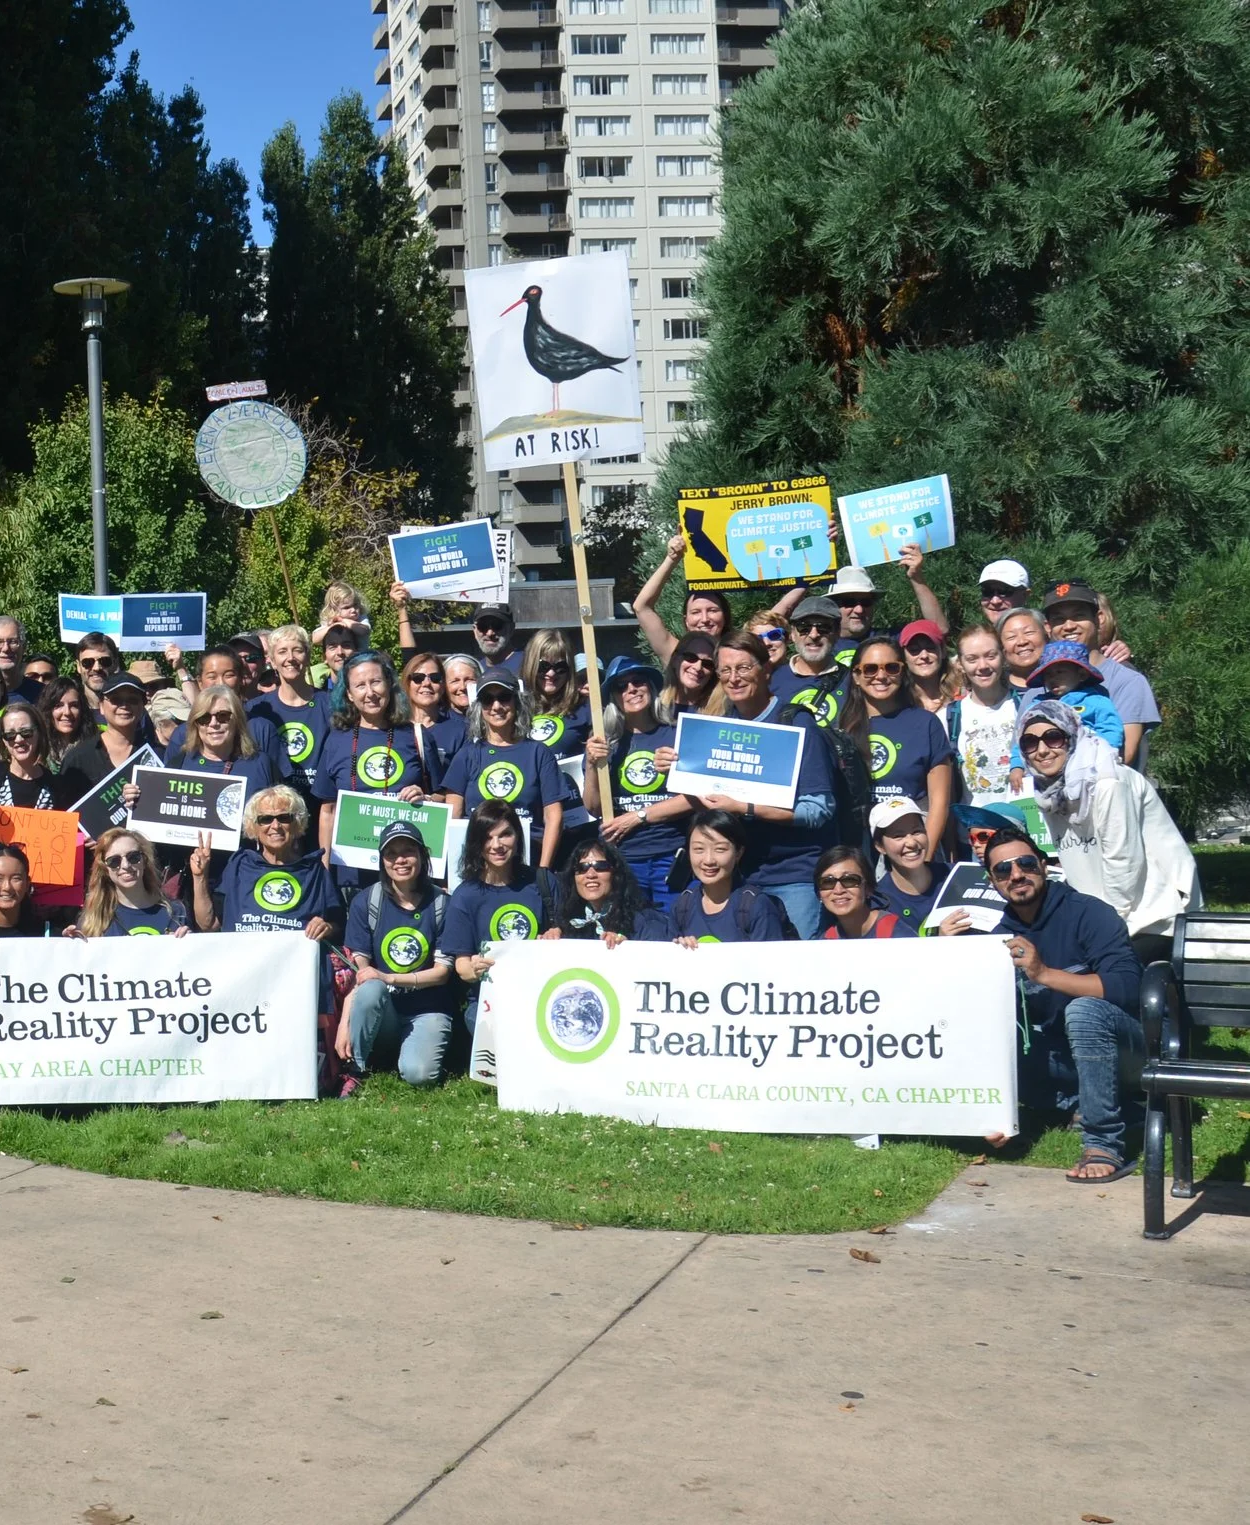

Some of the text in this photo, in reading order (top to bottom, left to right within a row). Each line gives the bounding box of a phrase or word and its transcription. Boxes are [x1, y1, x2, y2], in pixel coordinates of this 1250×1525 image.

[198, 425, 218, 464] EVEN
[212, 414, 223, 426] A
[272, 414, 299, 440] OLD
[515, 428, 600, 457] AT RISK!
[206, 452, 305, 505] CAN CLEAN UP
[680, 475, 827, 498] TEXT "BROWN" TO 69866
[730, 493, 813, 510] JERRY BROWN:
[857, 486, 931, 510] WE STAND FOR
[737, 509, 814, 525] WE STAND FOR
[852, 496, 941, 523] CLIMATE JUSTICE
[731, 520, 823, 537] CLIMATE JUSTICE
[424, 534, 458, 548] FIGHT
[422, 550, 463, 564] YOUR WORLD
[422, 558, 468, 574] DEPENDS ON IT
[150, 602, 178, 610] FIGHT
[66, 610, 105, 621] DENIAL A
[718, 729, 761, 744] FIGHT
[711, 748, 761, 764] YOUR WORLD
[707, 758, 763, 776] DEPENDS ON IT
[100, 777, 128, 804] THIS
[168, 780, 204, 795] THIS
[109, 809, 128, 826] OUR
[159, 802, 207, 819] OUR HOME
[359, 803, 428, 823] WE MUST, WE CAN
[40, 816, 71, 834] USE
[962, 888, 984, 899] OUR
[242, 914, 260, 923] The
[262, 915, 302, 928] Climate
[57, 971, 212, 1004] Climate
[633, 981, 881, 1016] The Climate
[628, 1022, 779, 1067] Reality
[32, 1059, 93, 1077] AREA
[100, 1058, 205, 1076] CHAPTER
[625, 1080, 1003, 1107] SANTA CLARA COUNTY, CA CHAPTER
